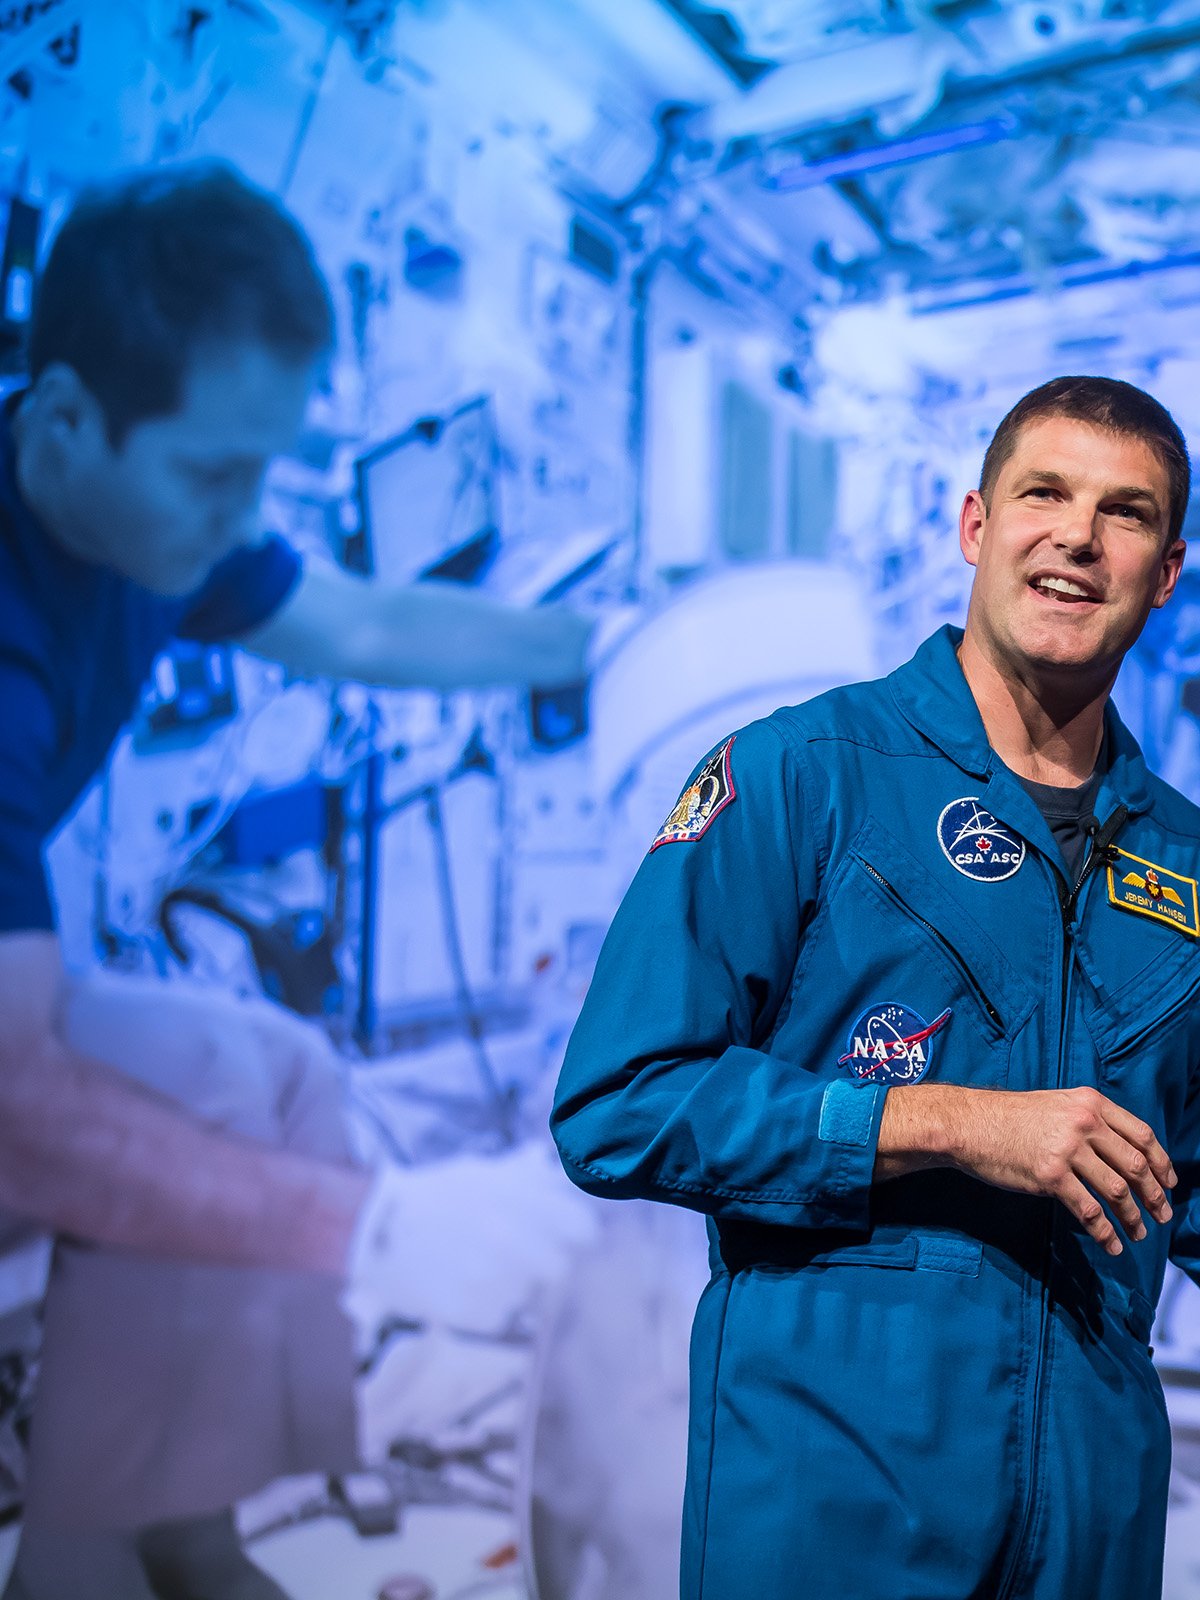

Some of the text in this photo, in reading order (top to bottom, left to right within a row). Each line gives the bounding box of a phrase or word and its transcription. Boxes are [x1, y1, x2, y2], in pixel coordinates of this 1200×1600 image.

[955, 853, 1020, 864] CSA ASC
[1124, 891, 1187, 923] JEREMY HANSEN
[852, 1036, 927, 1062] NASA
